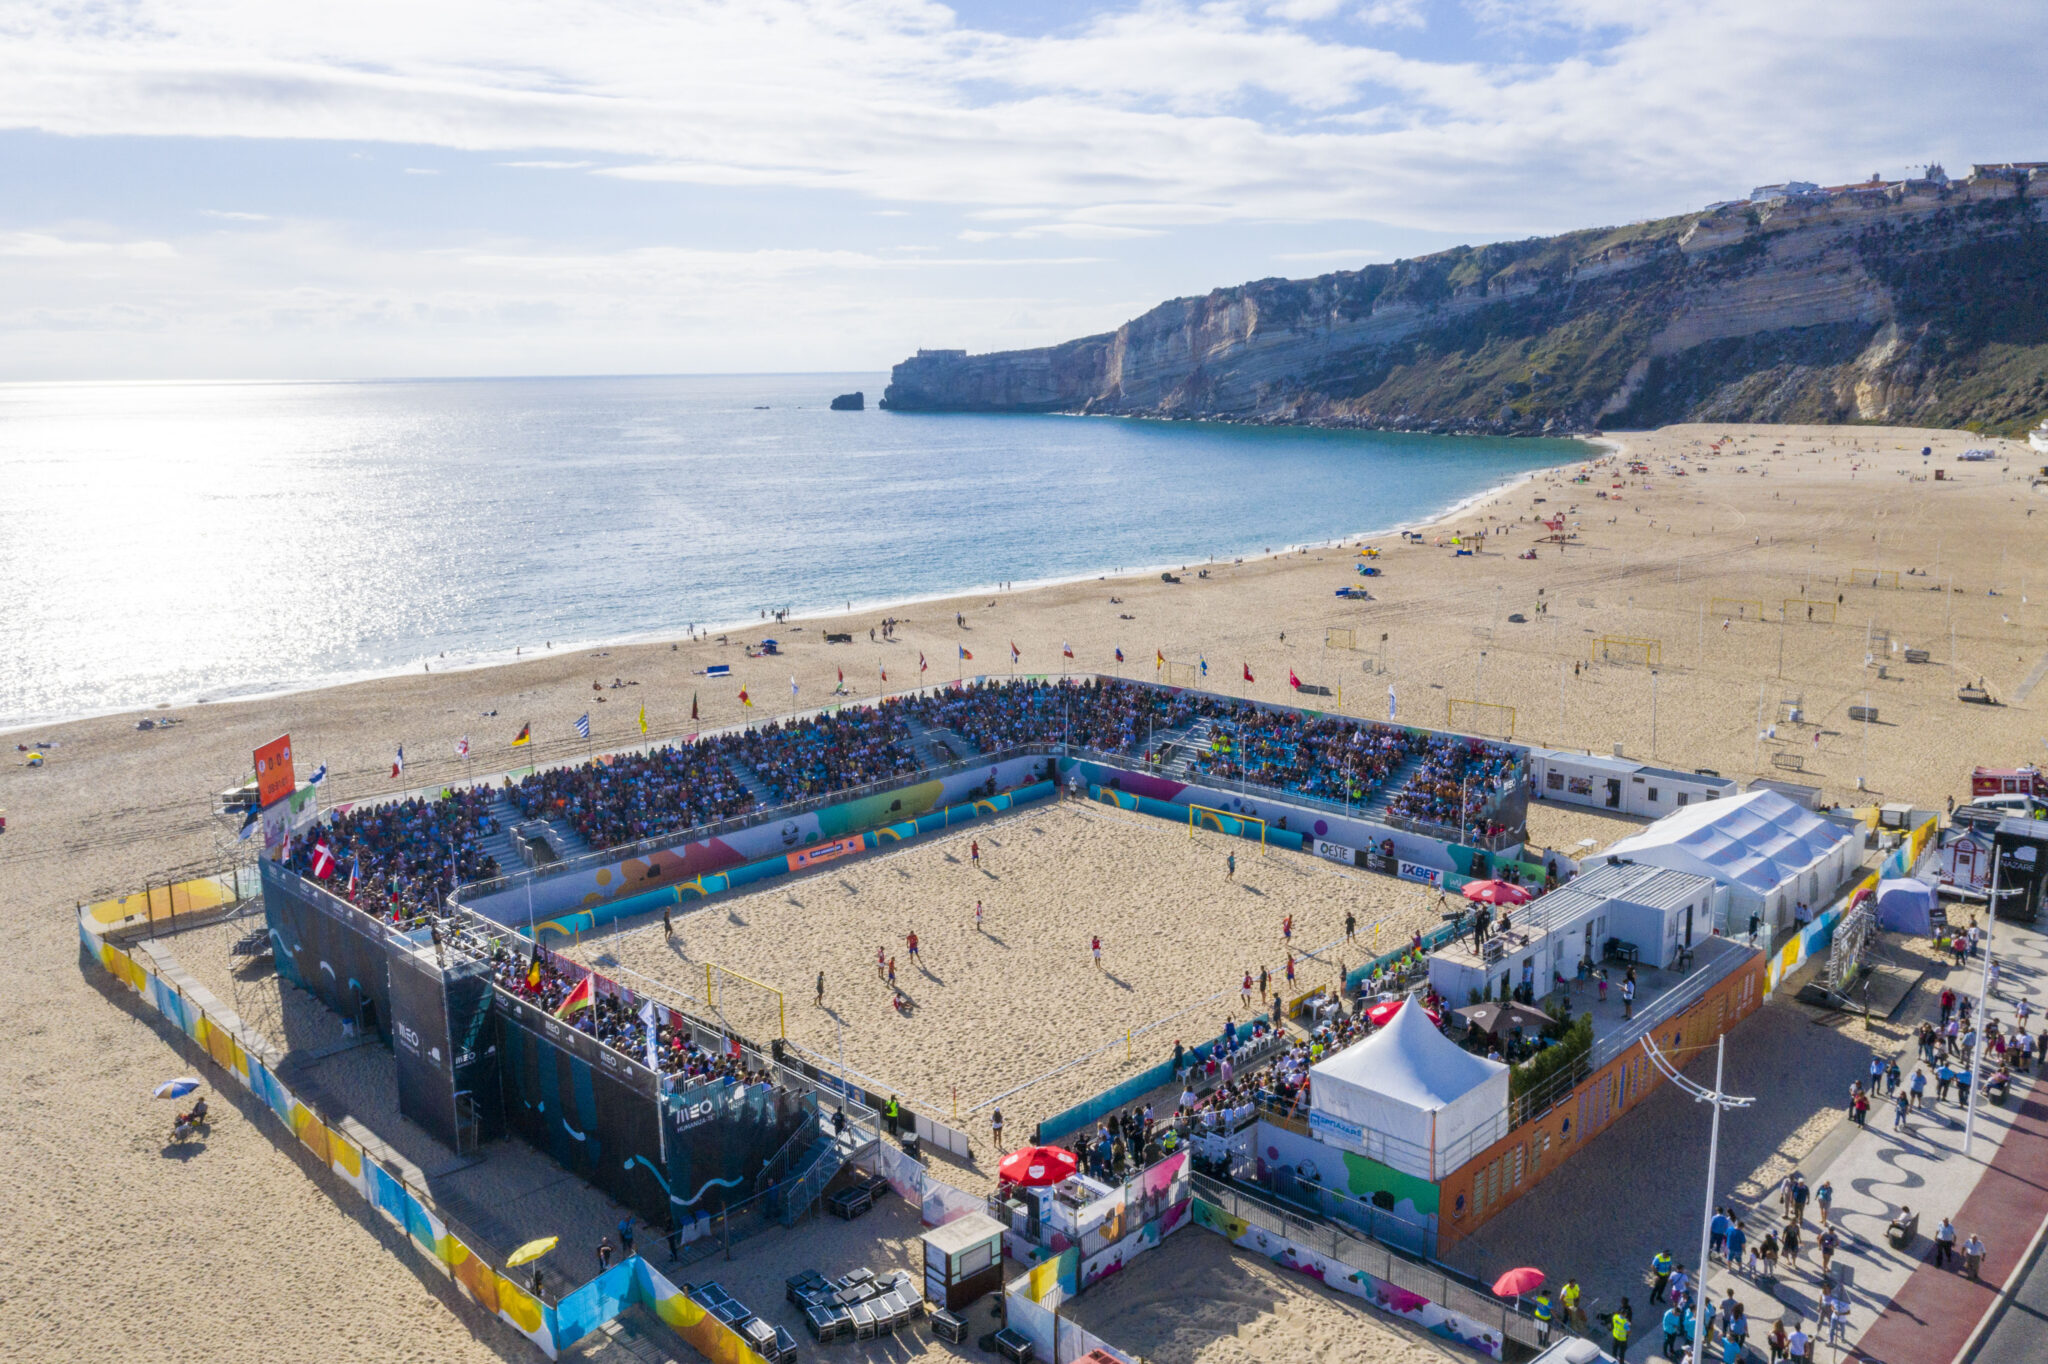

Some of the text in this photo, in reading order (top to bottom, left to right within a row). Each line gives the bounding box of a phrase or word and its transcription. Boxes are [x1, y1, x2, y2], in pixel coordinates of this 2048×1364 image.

[1320, 842, 1348, 860] OESTE
[1401, 863, 1440, 881] 1XBET
[399, 1022, 419, 1047] MEO
[545, 1020, 560, 1036] MEO
[456, 1051, 476, 1065] MEO
[600, 1050, 617, 1067] MEO
[676, 1099, 713, 1125] MEO
